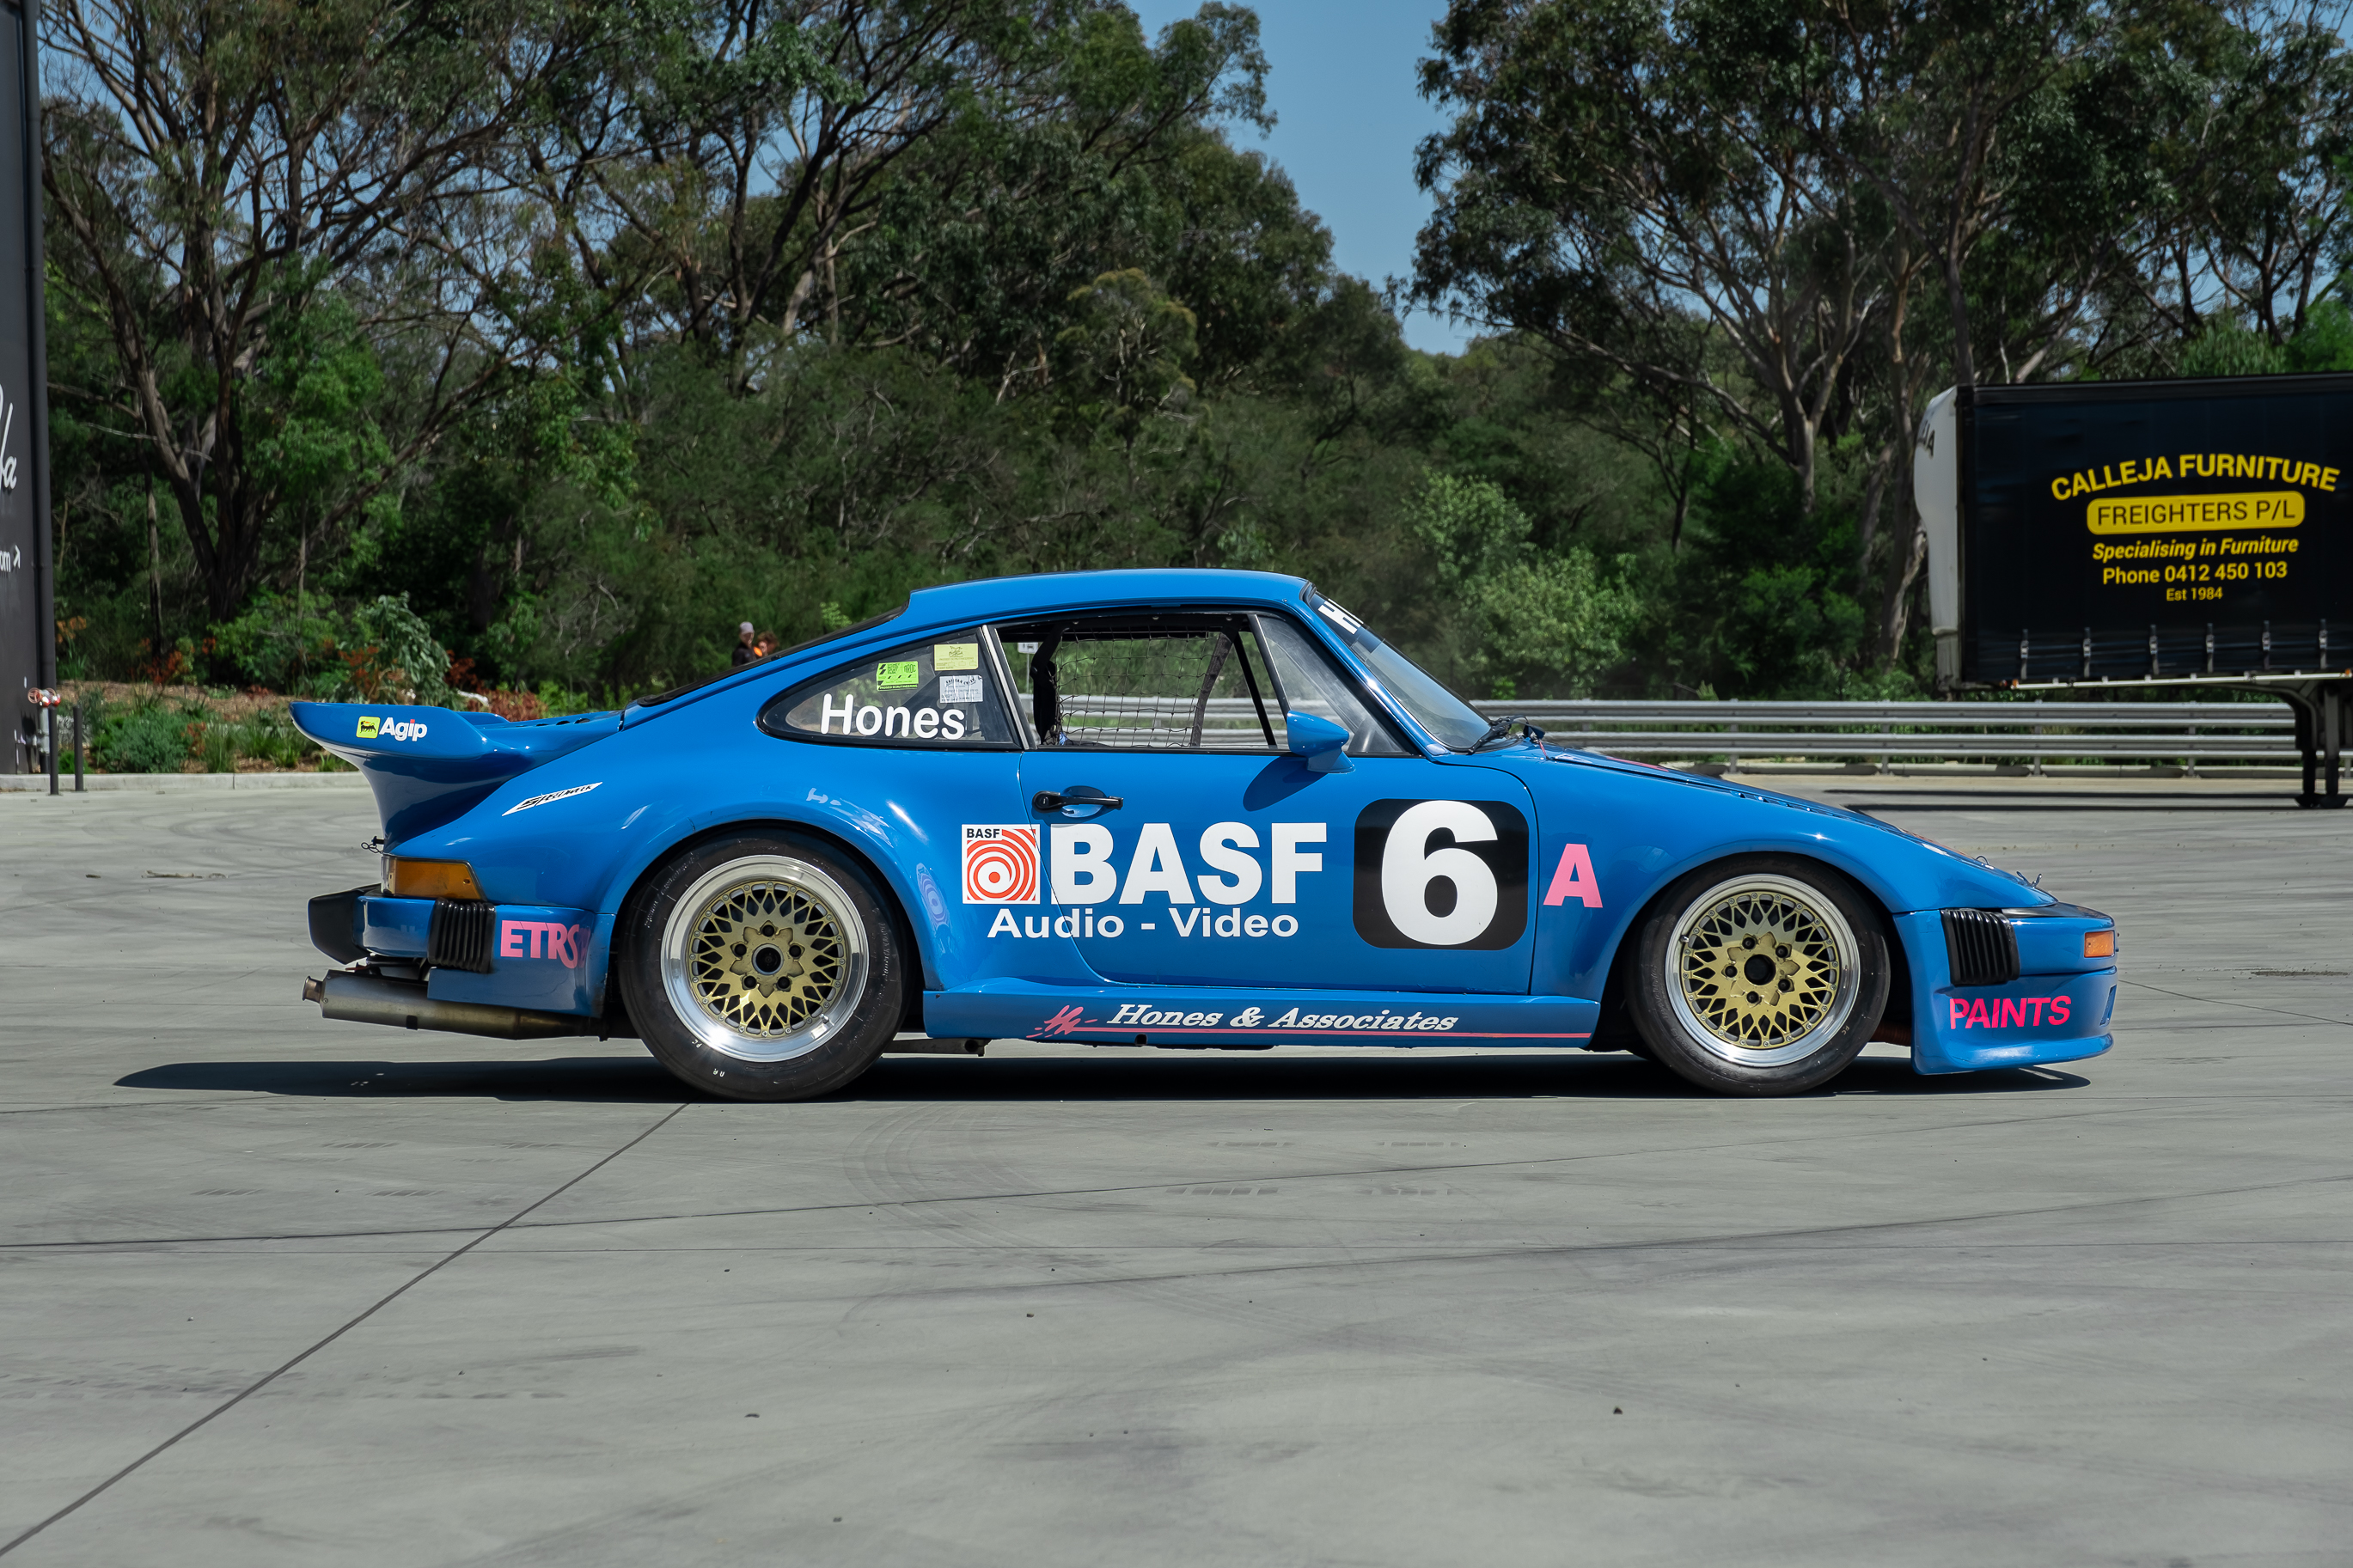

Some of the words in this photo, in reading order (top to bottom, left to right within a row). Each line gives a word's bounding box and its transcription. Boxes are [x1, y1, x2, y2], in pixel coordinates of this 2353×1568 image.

[2050, 455, 2173, 501] CALLEJA
[2179, 453, 2341, 492] FURNITURE
[2097, 500, 2248, 527] FREIGHTERS
[2255, 498, 2296, 522] P/L
[2092, 538, 2197, 564] Specialising
[2199, 540, 2216, 557] in
[2220, 534, 2300, 556] Furniture
[2103, 566, 2160, 585] Phone
[2164, 564, 2210, 583] 0412
[2215, 561, 2249, 581] 450
[2253, 560, 2288, 579] 103
[2166, 588, 2188, 601] Est
[2190, 586, 2224, 601] 1984
[379, 717, 428, 741] Agip
[820, 693, 966, 740] Hones
[966, 827, 1000, 839] BASF
[1050, 821, 1328, 906] BASF
[1381, 800, 1498, 945] 6
[1543, 843, 1604, 908] A
[987, 908, 1125, 938] Audio
[1168, 907, 1299, 938] Video
[1107, 1004, 1224, 1028] Hones
[1231, 1006, 1265, 1028] &
[1268, 1008, 1459, 1031] Associates
[1949, 995, 2072, 1029] PAINTS
